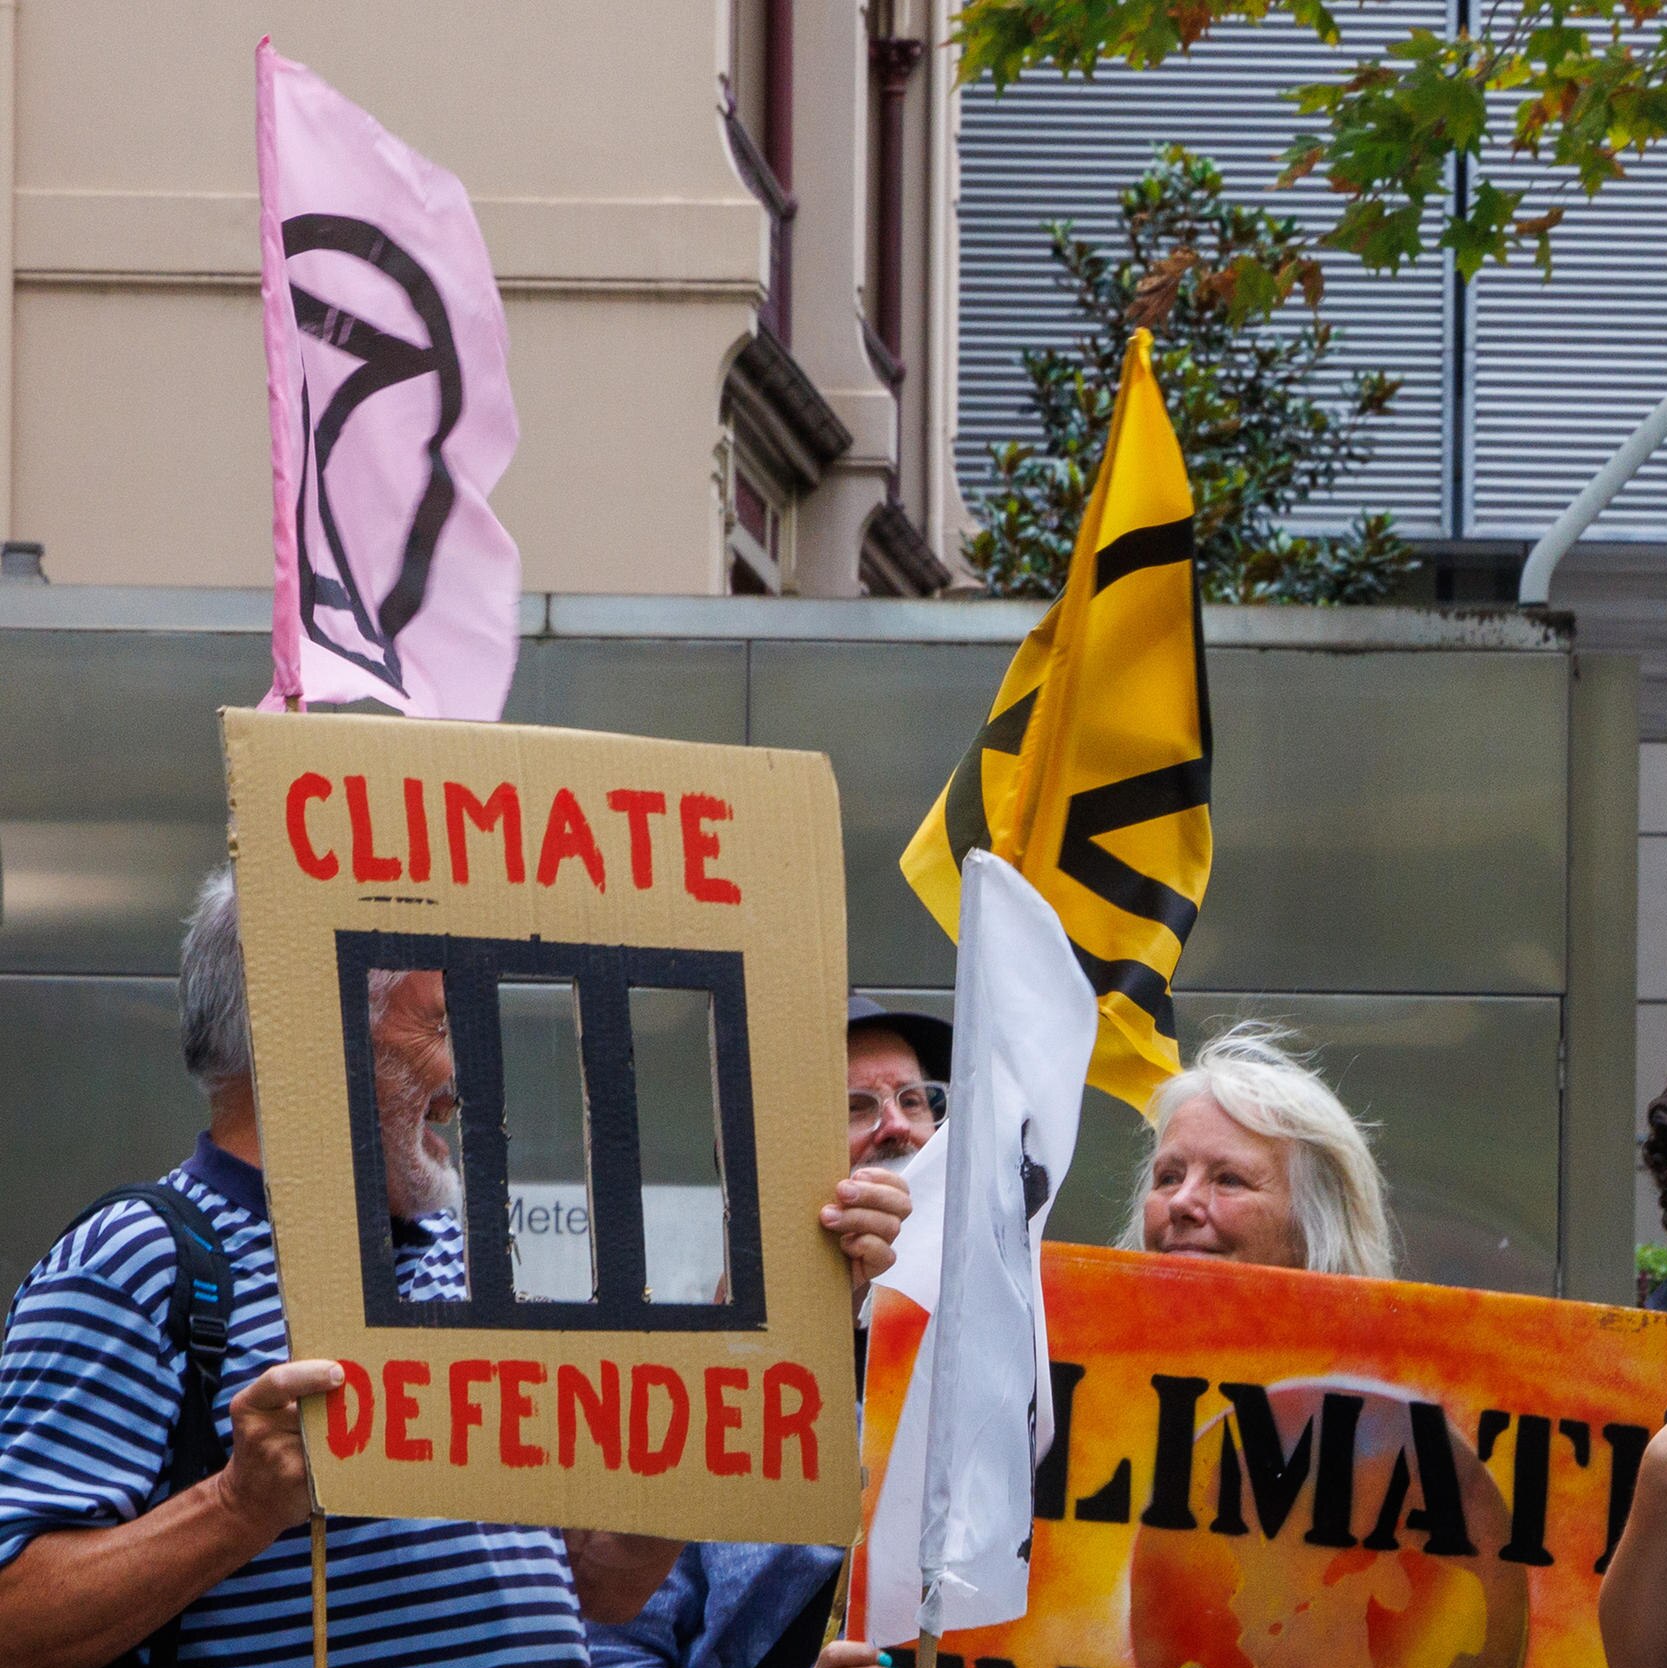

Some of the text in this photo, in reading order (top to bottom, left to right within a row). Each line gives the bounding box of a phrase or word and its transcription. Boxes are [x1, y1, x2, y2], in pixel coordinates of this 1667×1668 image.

[286, 772, 742, 905] CLIMATE
[326, 1359, 824, 1482] DEFENDER
[1034, 1360, 1650, 1574] LIMAT
